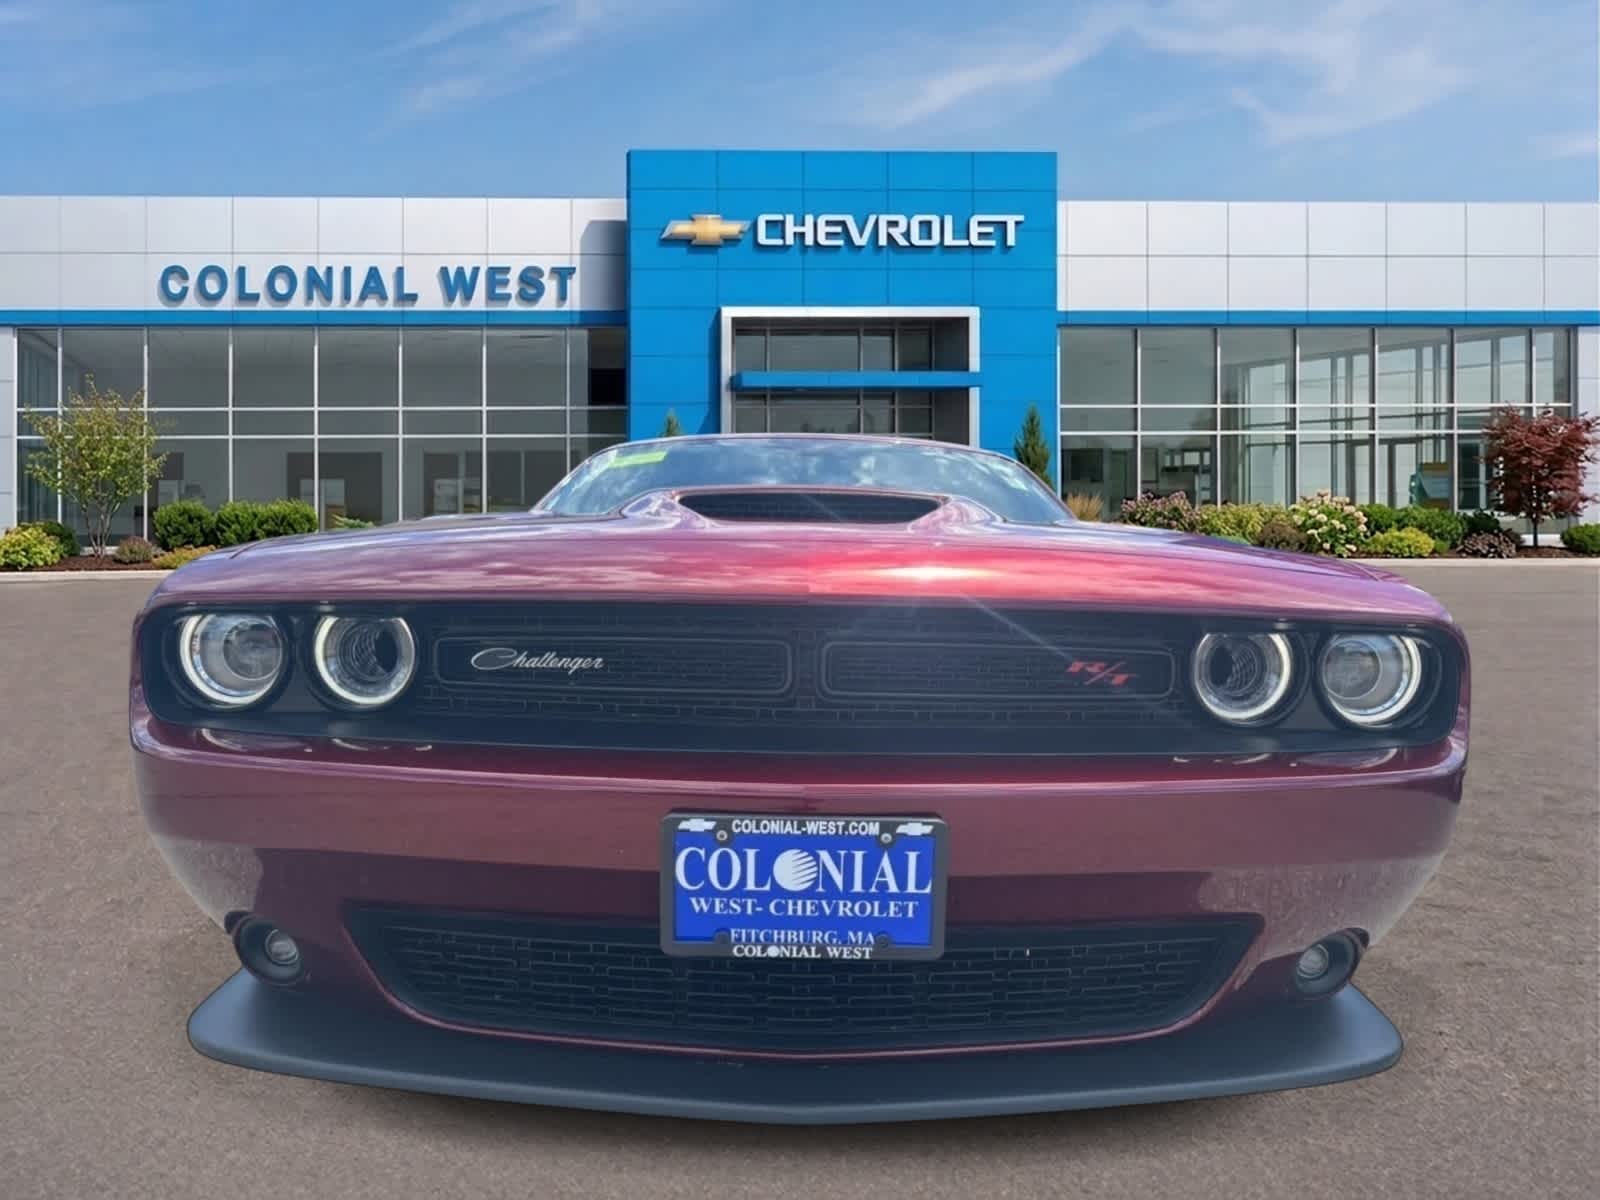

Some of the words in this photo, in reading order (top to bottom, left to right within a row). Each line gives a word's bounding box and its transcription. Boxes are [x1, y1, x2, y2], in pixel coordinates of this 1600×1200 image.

[756, 213, 1025, 248] CHEVROLET
[158, 264, 418, 307] COLONIAL
[438, 265, 577, 306] WEST
[470, 647, 606, 675] Challenger
[731, 819, 880, 836] COLONIAL-WEST.COM
[675, 846, 932, 894] COLONIAL
[768, 898, 919, 919] CHEVROLET
[847, 930, 876, 946] MA
[731, 944, 821, 959] COLONIAL
[826, 945, 873, 960] WEST
